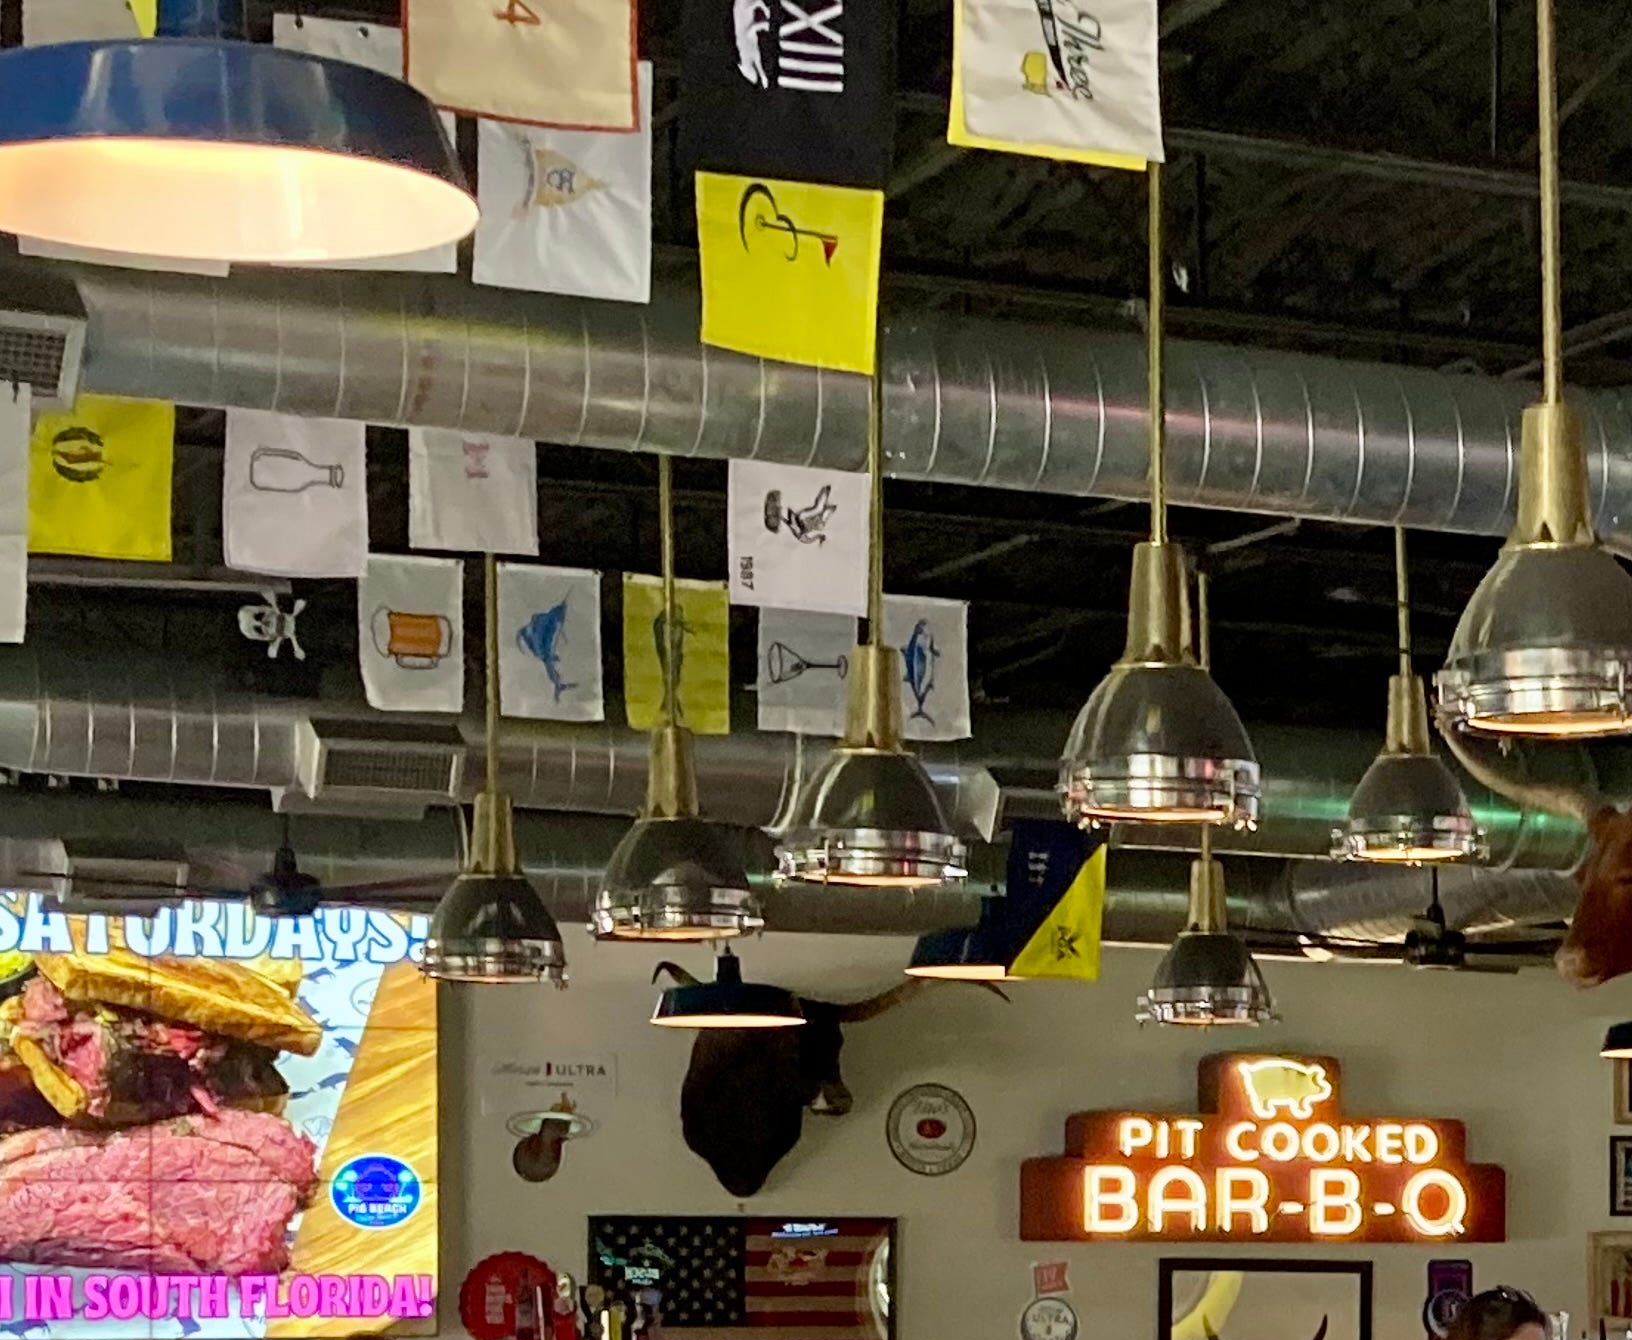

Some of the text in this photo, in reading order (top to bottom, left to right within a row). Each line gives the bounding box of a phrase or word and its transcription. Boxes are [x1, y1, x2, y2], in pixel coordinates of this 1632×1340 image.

[1055, 8, 1105, 101] Three
[740, 556, 755, 591] 1987
[556, 1064, 606, 1077] ULTRA
[1118, 1117, 1440, 1165] PIT COOKED
[1082, 1164, 1468, 1237] BAR-B-Q
[24, 1274, 74, 1321] IN
[83, 1273, 229, 1321] SOUTH
[239, 1273, 434, 1320] FLORIDA!
